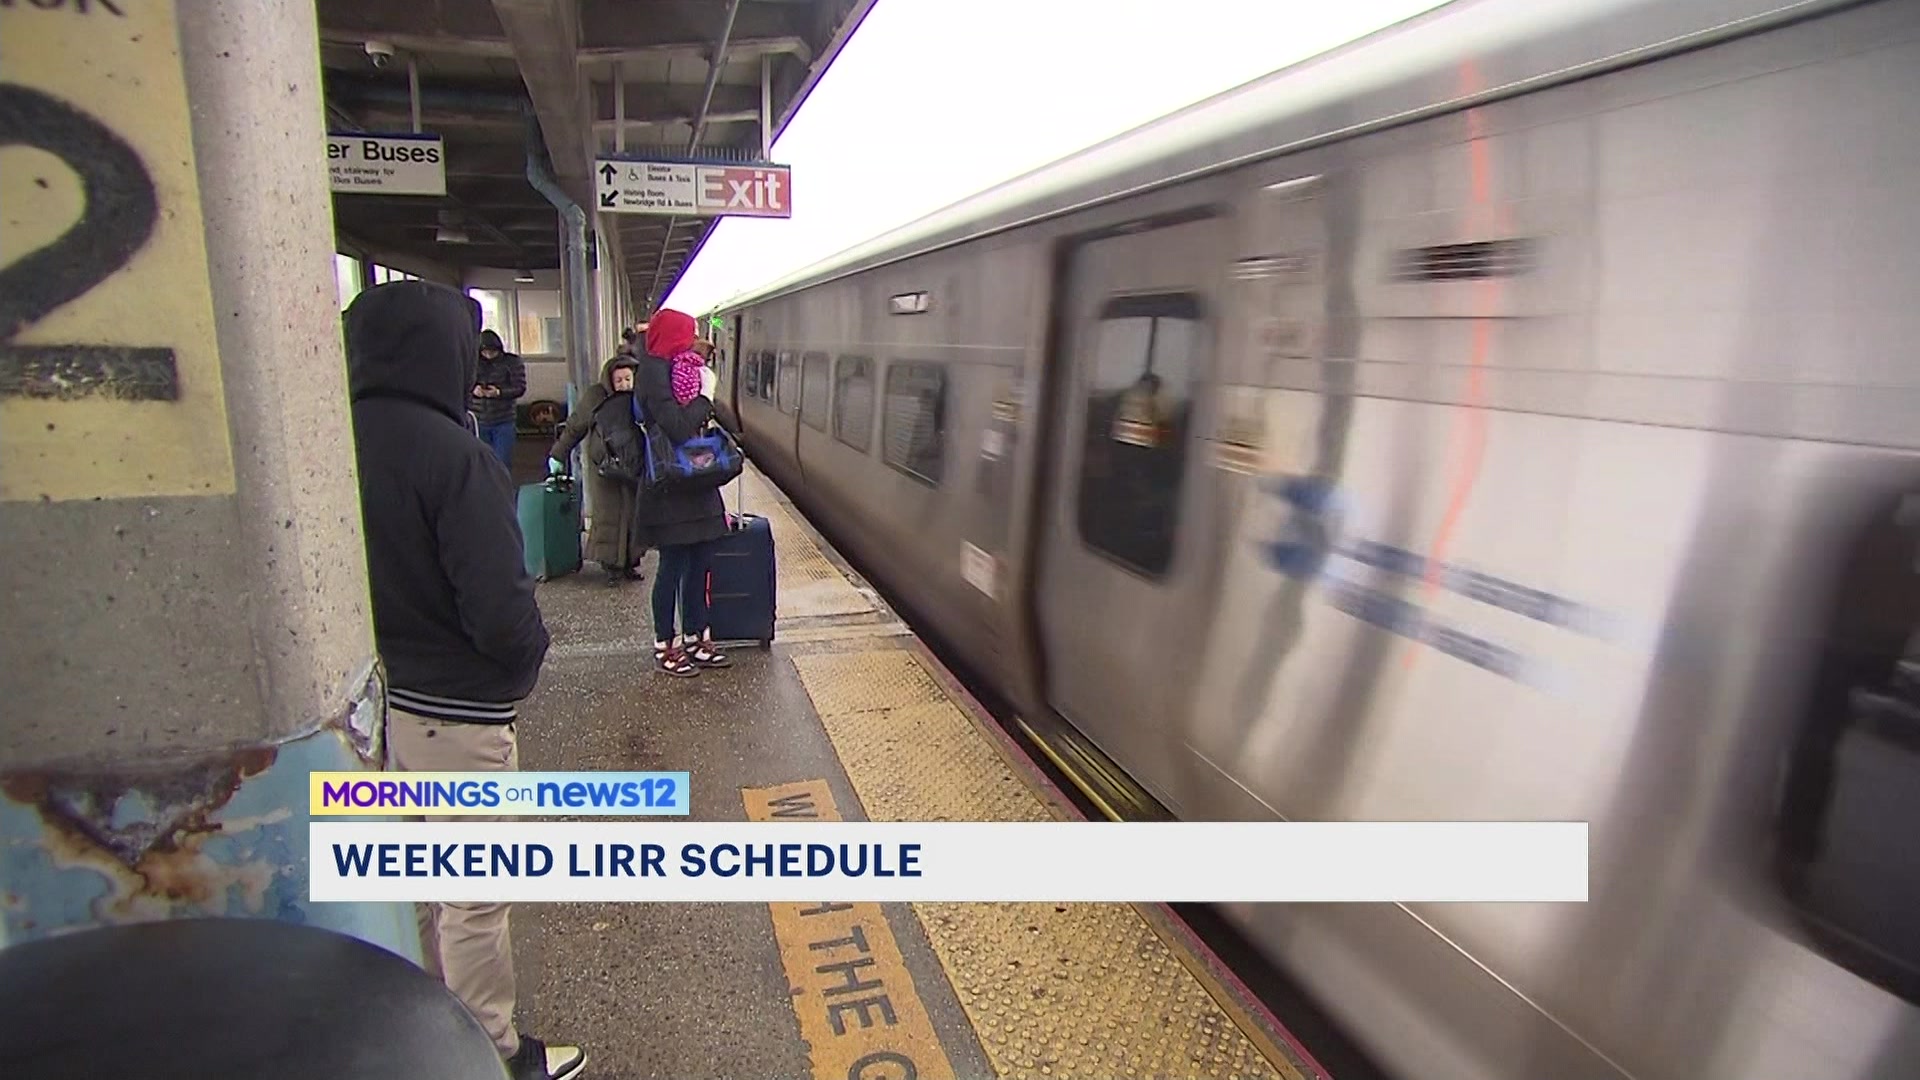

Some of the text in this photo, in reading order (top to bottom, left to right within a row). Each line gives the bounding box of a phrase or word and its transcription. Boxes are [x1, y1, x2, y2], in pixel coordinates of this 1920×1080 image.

[363, 141, 439, 163] Buses
[701, 169, 782, 209] Exit
[808, 925, 898, 1036] THE
